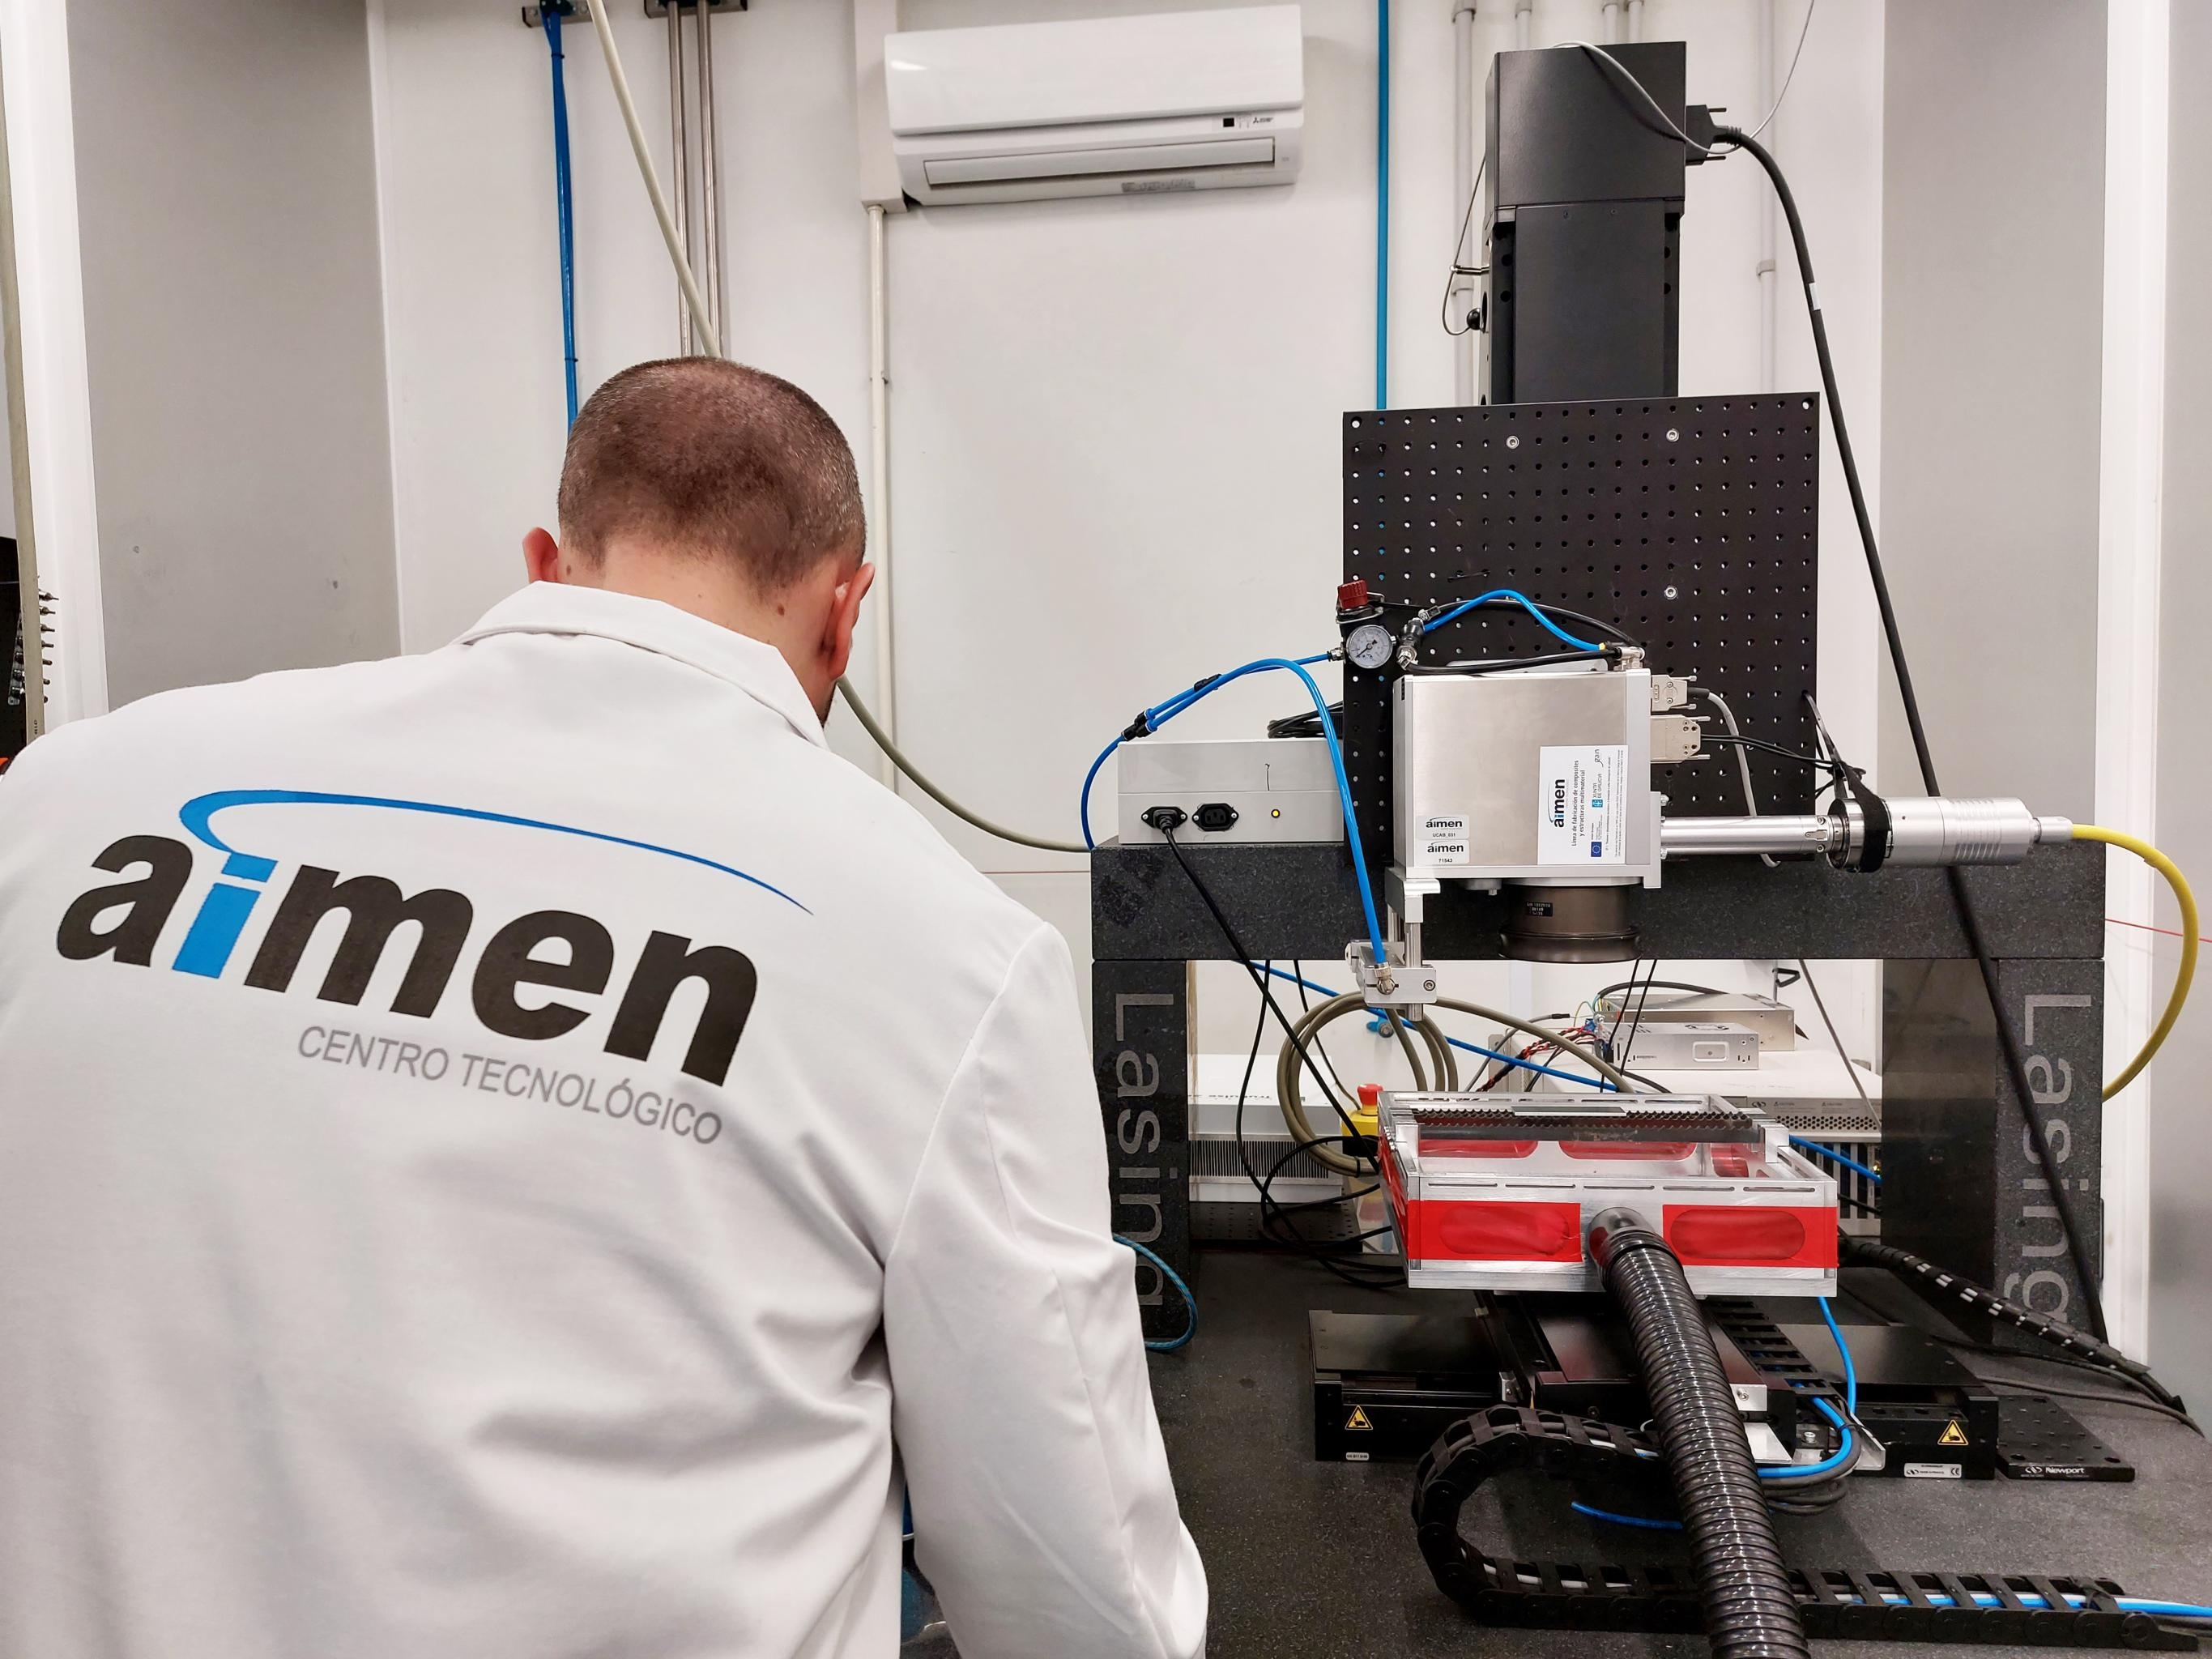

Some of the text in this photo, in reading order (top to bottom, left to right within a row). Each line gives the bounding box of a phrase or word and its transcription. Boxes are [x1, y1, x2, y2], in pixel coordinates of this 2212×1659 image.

[1554, 779, 1565, 828] aimen
[57, 835, 757, 1086] aimen
[297, 1025, 722, 1145] CENTRO TECNOLÓGICO
